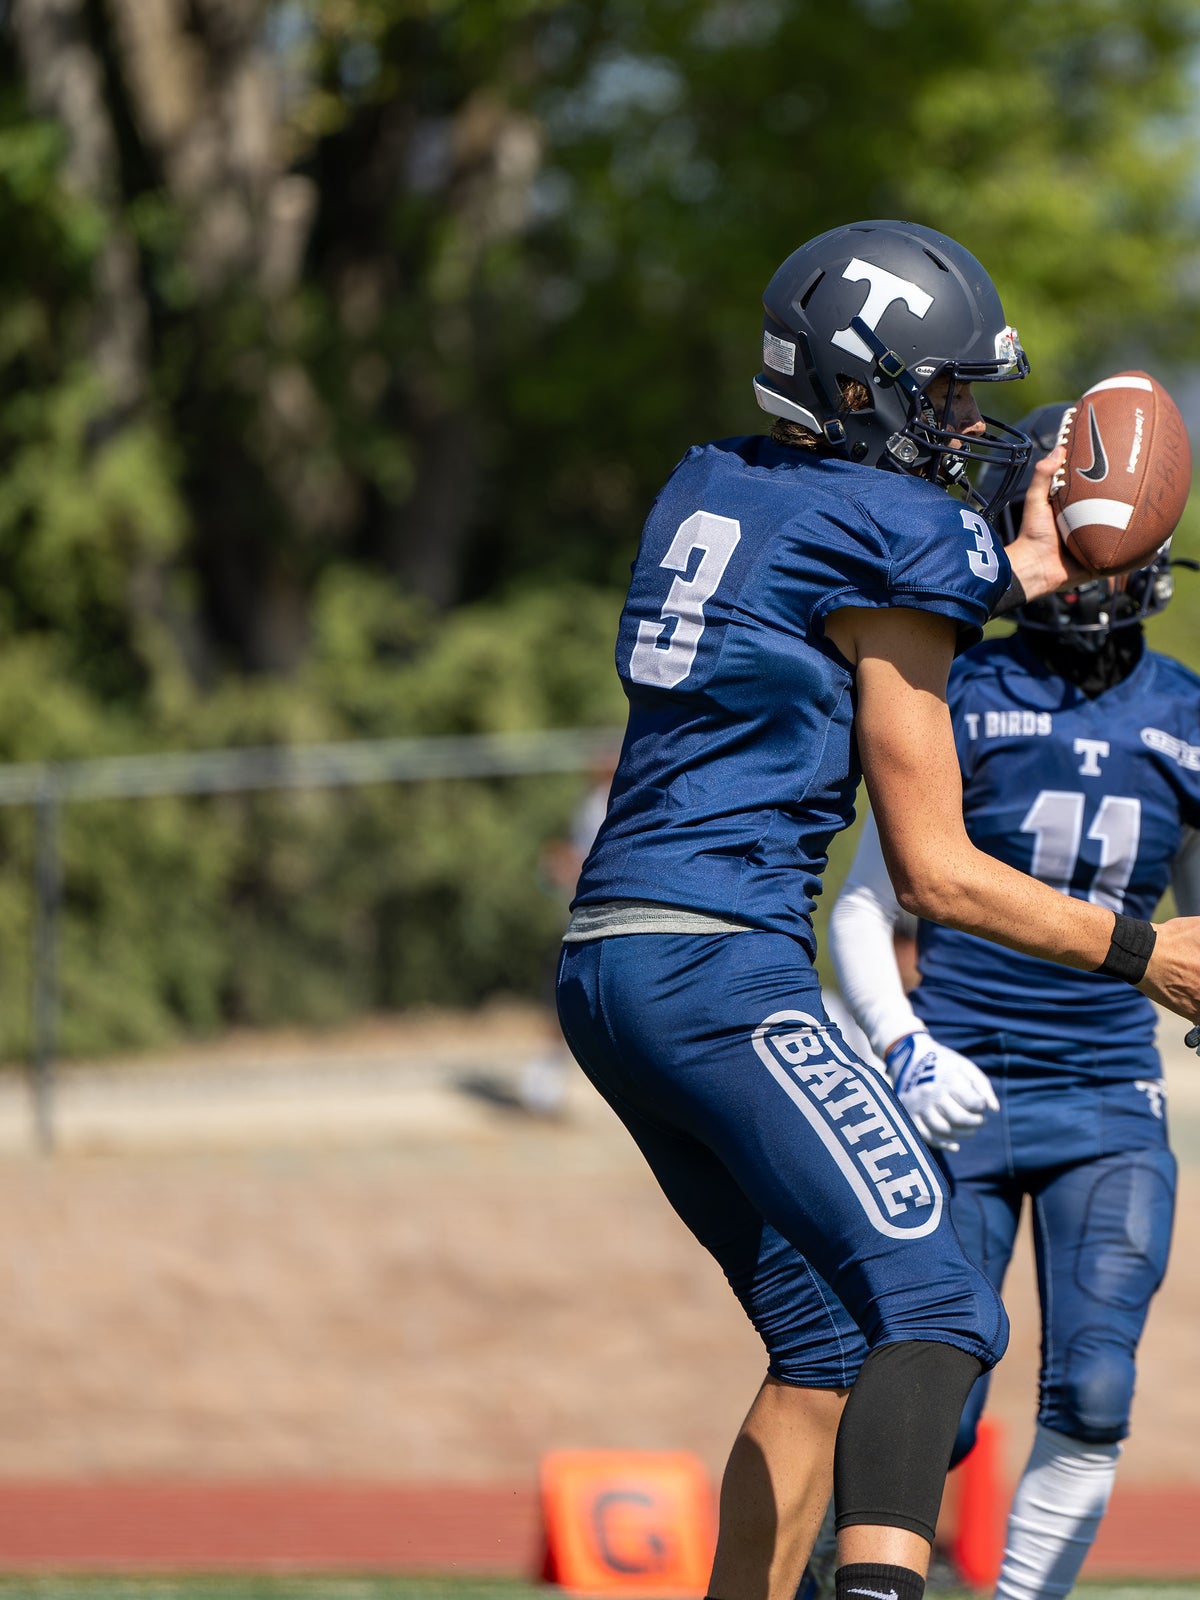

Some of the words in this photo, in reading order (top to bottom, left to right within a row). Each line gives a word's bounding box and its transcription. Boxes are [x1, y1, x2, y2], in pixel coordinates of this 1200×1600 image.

[829, 257, 935, 363] T
[959, 509, 999, 584] 3
[629, 510, 741, 690] 3
[963, 712, 981, 741] T
[984, 710, 1053, 739] BIRDS
[1073, 737, 1110, 778] T
[1020, 789, 1142, 915] 11
[770, 1027, 932, 1218] BATTLE
[591, 1491, 666, 1573] G
